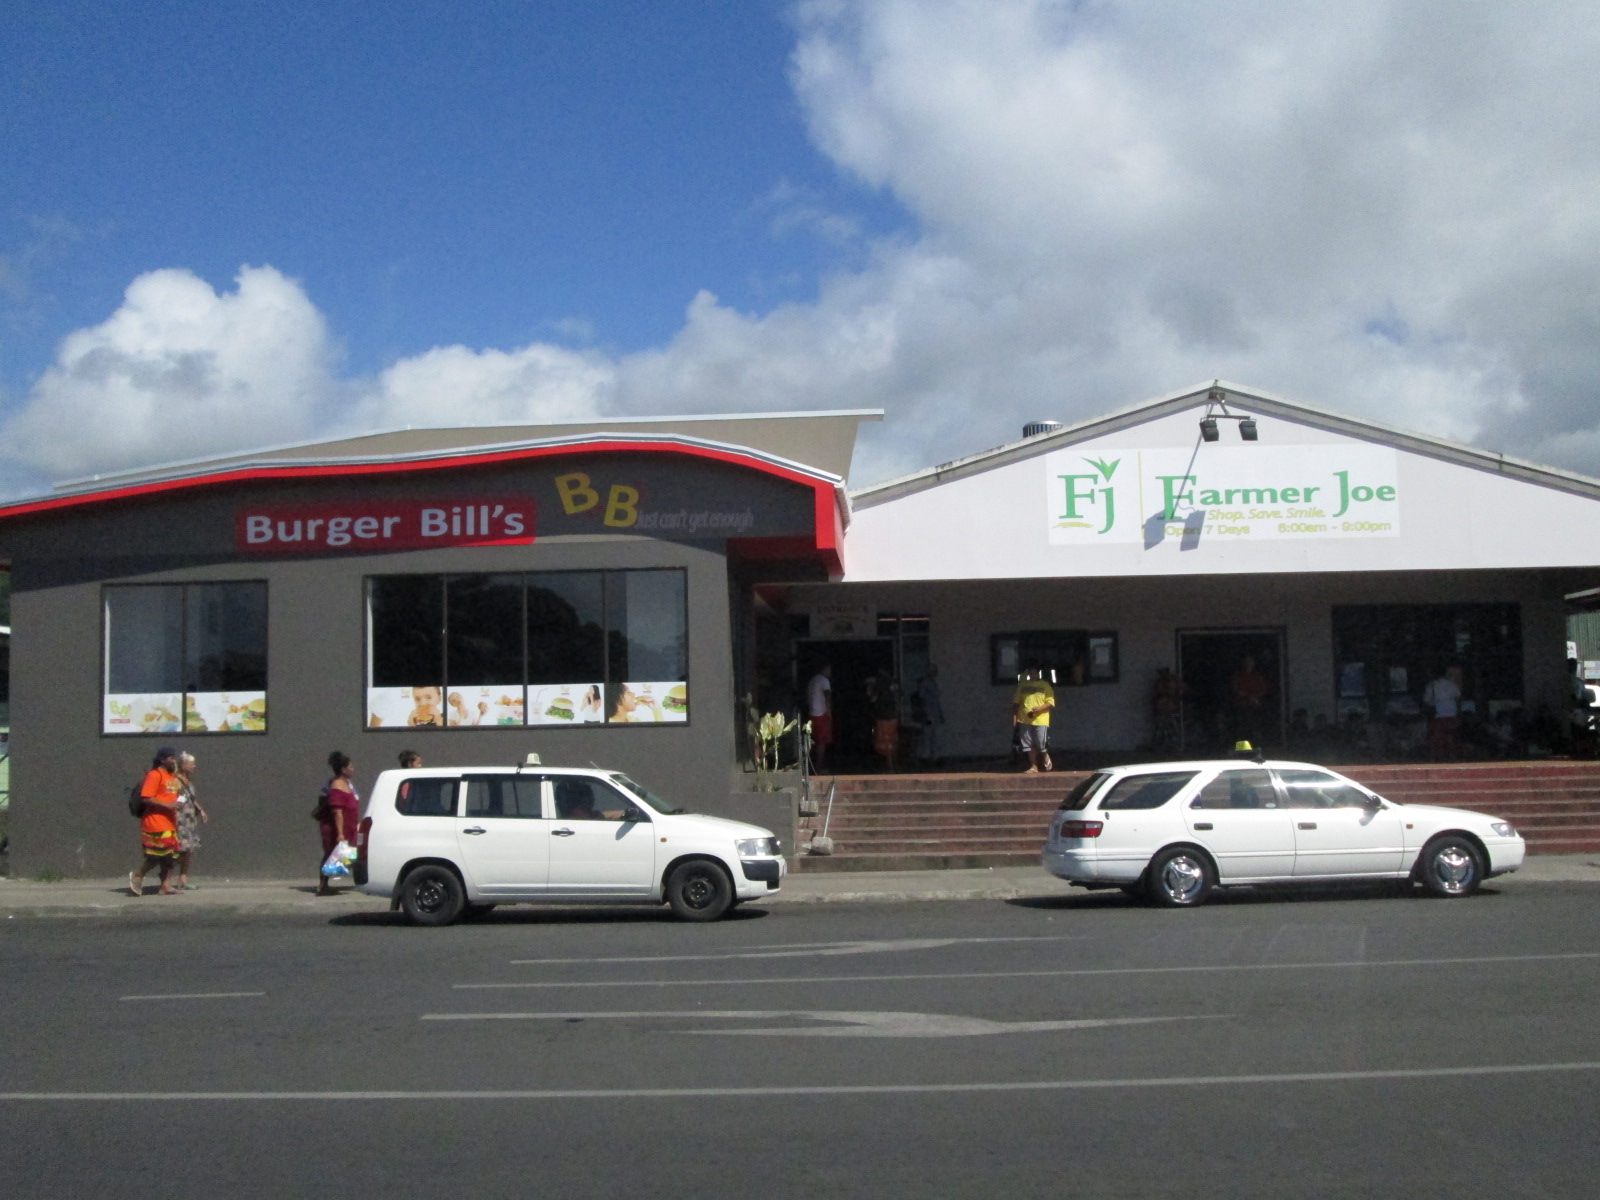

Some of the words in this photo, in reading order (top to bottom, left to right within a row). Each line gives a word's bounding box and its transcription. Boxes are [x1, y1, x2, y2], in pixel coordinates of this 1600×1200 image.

[1155, 475, 1321, 521] Farmer
[1332, 470, 1397, 518] Joe
[246, 515, 400, 546] Burger
[420, 504, 525, 537] Bill's
[689, 510, 709, 533] get
[710, 507, 754, 533] enough
[1204, 525, 1214, 535] 7
[1217, 524, 1250, 536] Days
